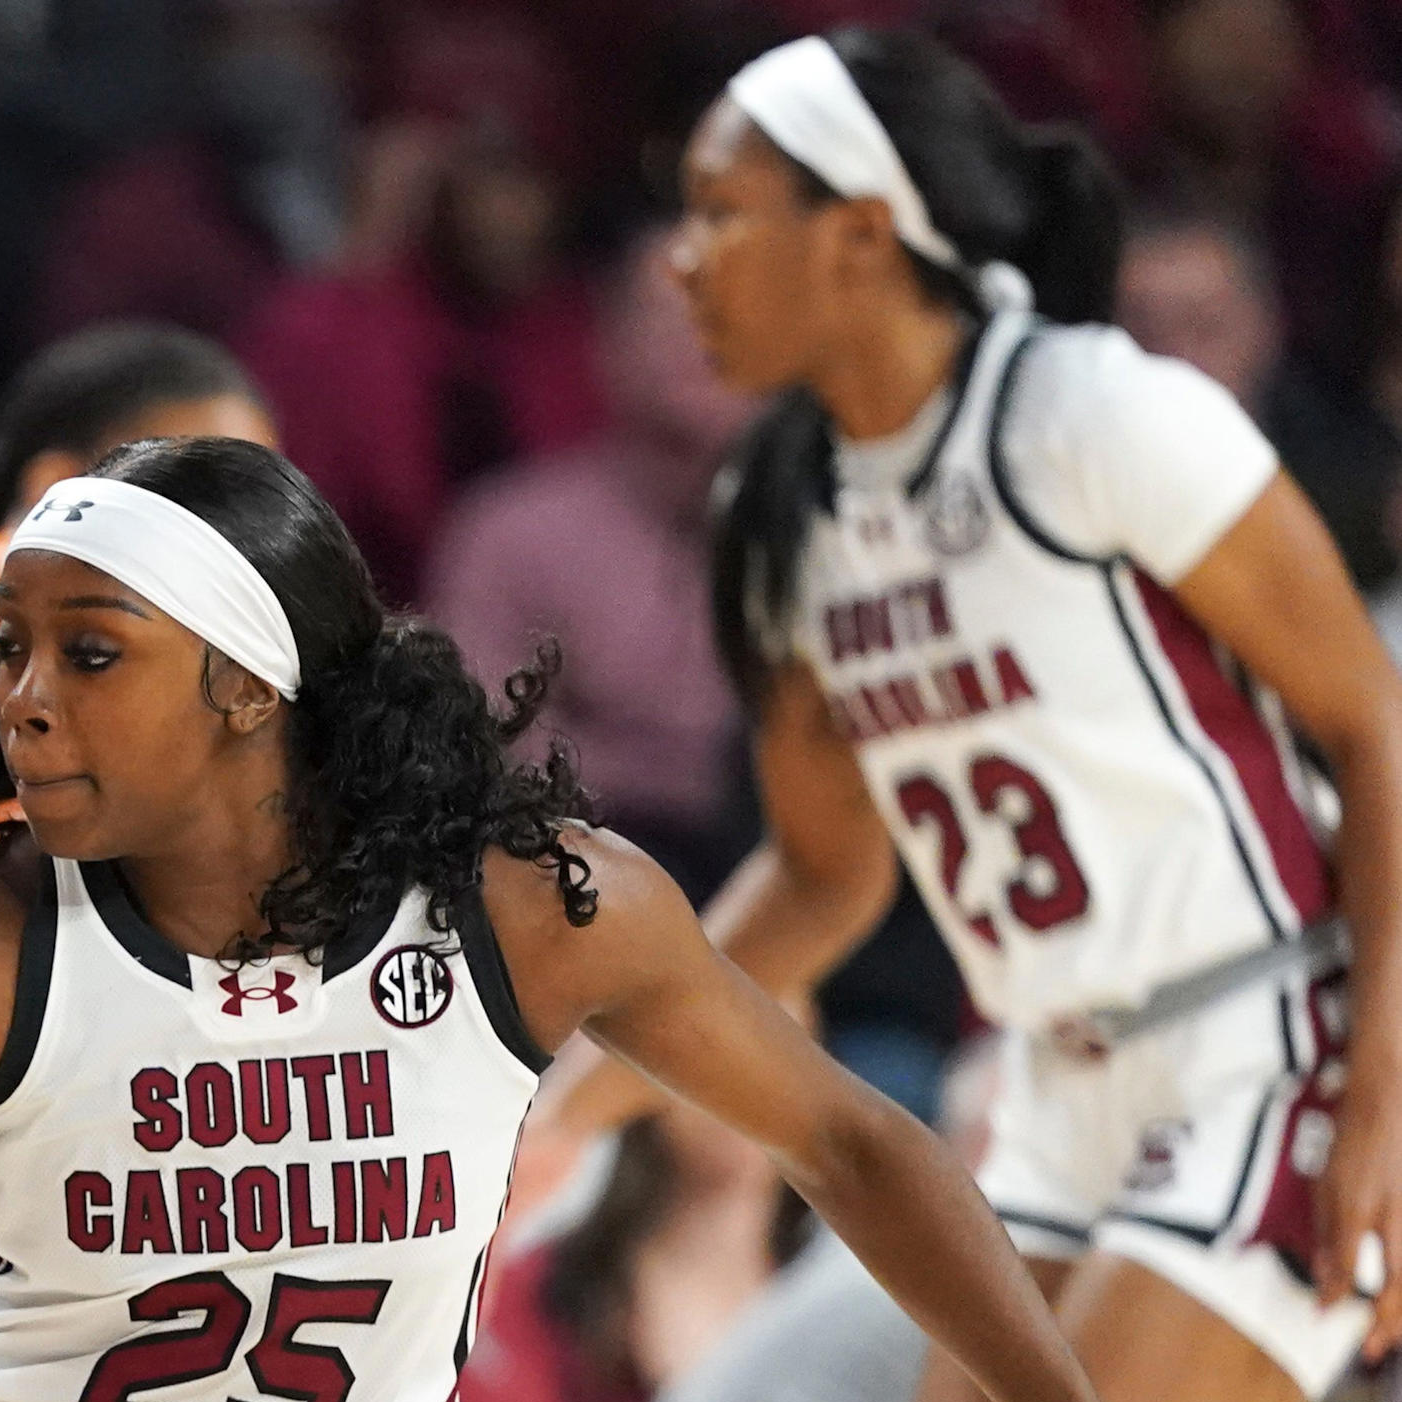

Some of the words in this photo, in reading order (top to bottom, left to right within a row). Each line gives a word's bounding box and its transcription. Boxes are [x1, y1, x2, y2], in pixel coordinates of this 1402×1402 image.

[894, 754, 1091, 950] 23
[378, 950, 448, 1025] SEC
[130, 1049, 394, 1153] SOUTH
[64, 1149, 457, 1255] CAROLINA
